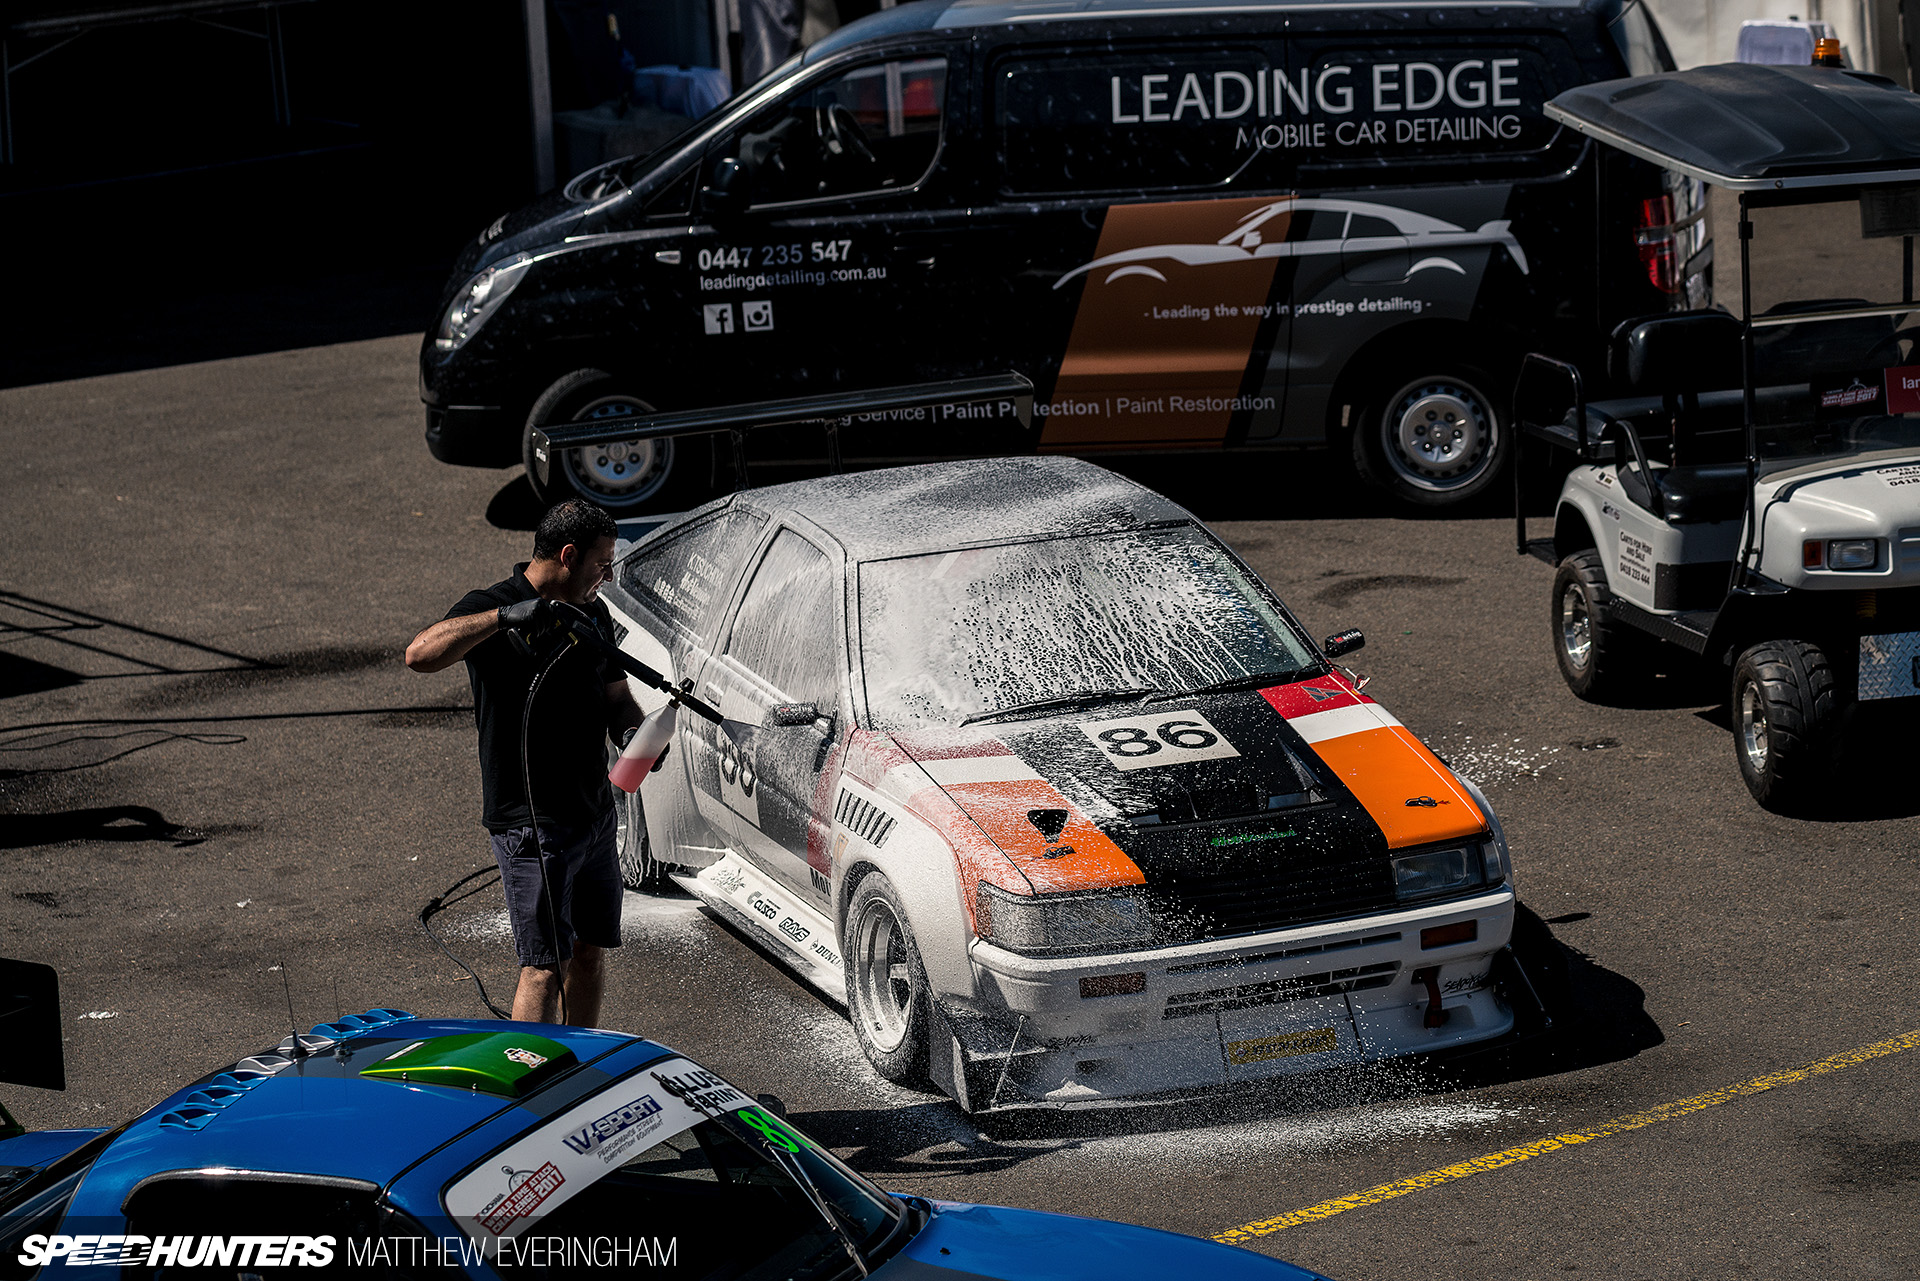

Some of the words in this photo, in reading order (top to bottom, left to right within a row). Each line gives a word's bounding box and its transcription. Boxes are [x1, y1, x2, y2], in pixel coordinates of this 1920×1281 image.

[1111, 65, 1354, 124] LEADING
[1373, 58, 1521, 112] EDGE
[1235, 122, 1327, 150] MOBILE
[1336, 120, 1388, 146] CAR
[1395, 114, 1522, 144] DETAILING
[698, 247, 752, 271] 0447
[762, 244, 803, 266] 235
[811, 240, 852, 263] 547
[700, 267, 886, 291] leadingdetailing.com.au
[1153, 305, 1210, 321] Leading
[1214, 303, 1239, 317] the
[1242, 304, 1272, 318] way
[1276, 302, 1290, 315] in
[1294, 299, 1354, 318] prestige
[1357, 297, 1422, 314] detailing
[943, 402, 993, 420] Paint
[999, 399, 1099, 418] Prtection
[1117, 397, 1164, 414] Paint
[1169, 394, 1276, 413] Restoration
[1857, 392, 1877, 402] 2017
[1098, 720, 1218, 757] 86
[778, 916, 811, 942] RAYS
[597, 1127, 637, 1159] PERFORMANCE
[636, 1116, 655, 1131] STREET
[603, 1137, 636, 1164] COMPETITION
[636, 1121, 664, 1141] EQUIPMENT
[484, 1199, 514, 1228] WORLD
[510, 1184, 531, 1203] TIME
[528, 1163, 555, 1188] ATTACK
[492, 1190, 537, 1233] CHALLENGE
[535, 1169, 563, 1198] 2017
